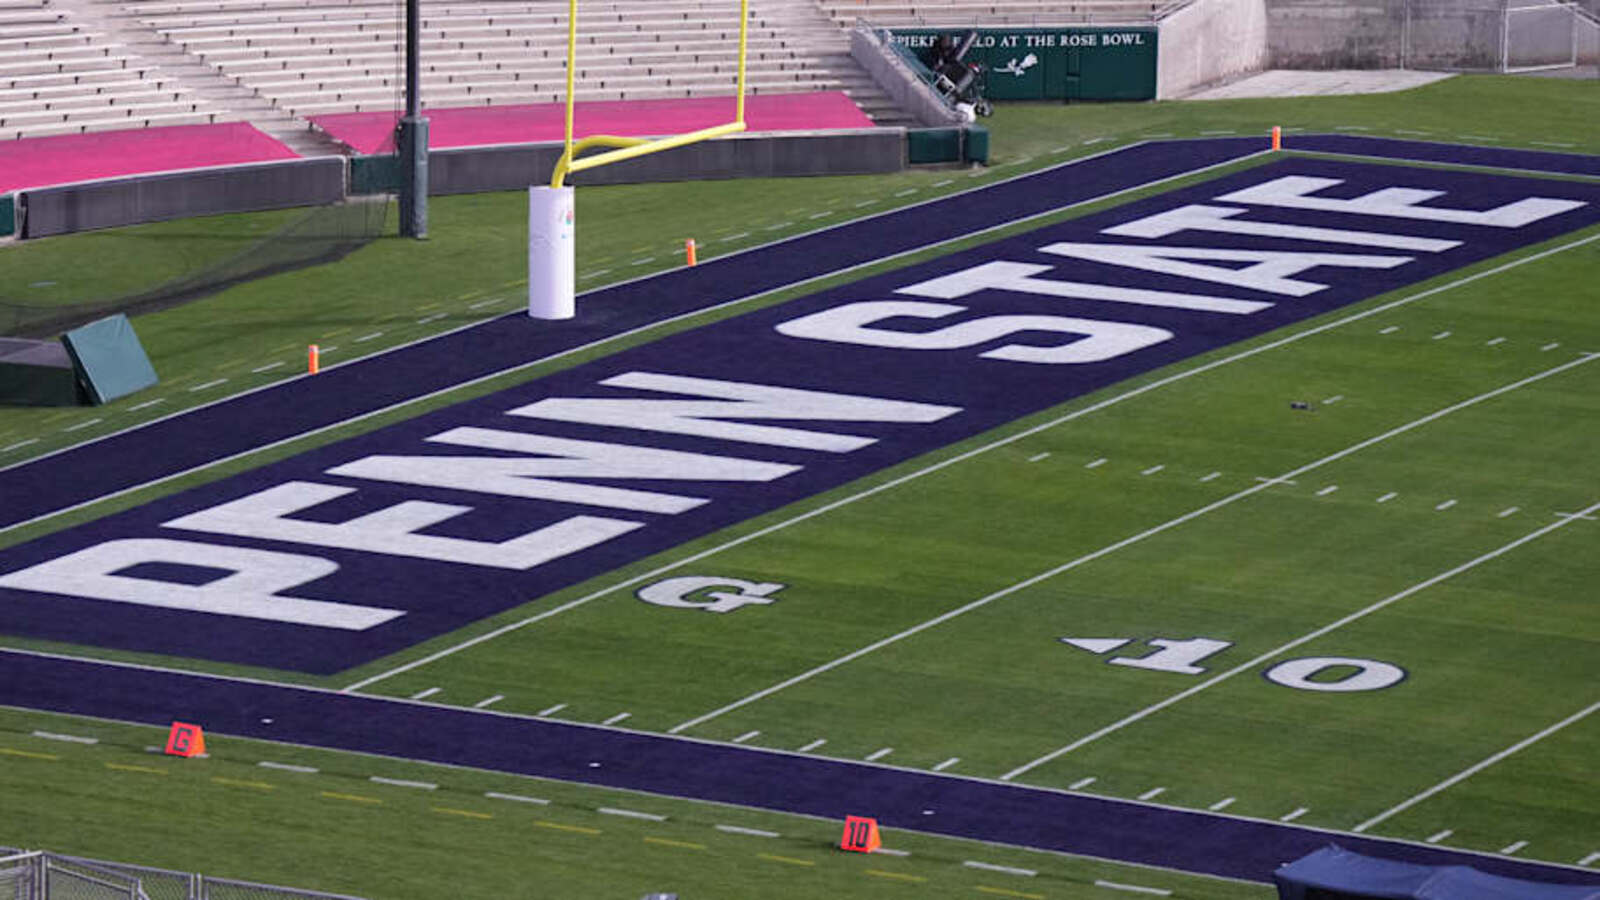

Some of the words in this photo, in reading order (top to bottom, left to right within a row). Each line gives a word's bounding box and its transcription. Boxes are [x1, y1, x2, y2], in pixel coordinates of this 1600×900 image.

[952, 35, 996, 48] FLD
[1000, 35, 1020, 47] AT
[1024, 35, 1056, 47] THE
[1060, 34, 1098, 46] ROSE
[1102, 33, 1145, 46] BOWL
[0, 372, 962, 630] PENN
[776, 176, 1587, 364] STATE
[635, 575, 786, 614] G
[173, 727, 193, 752] G
[848, 821, 869, 848] 10
